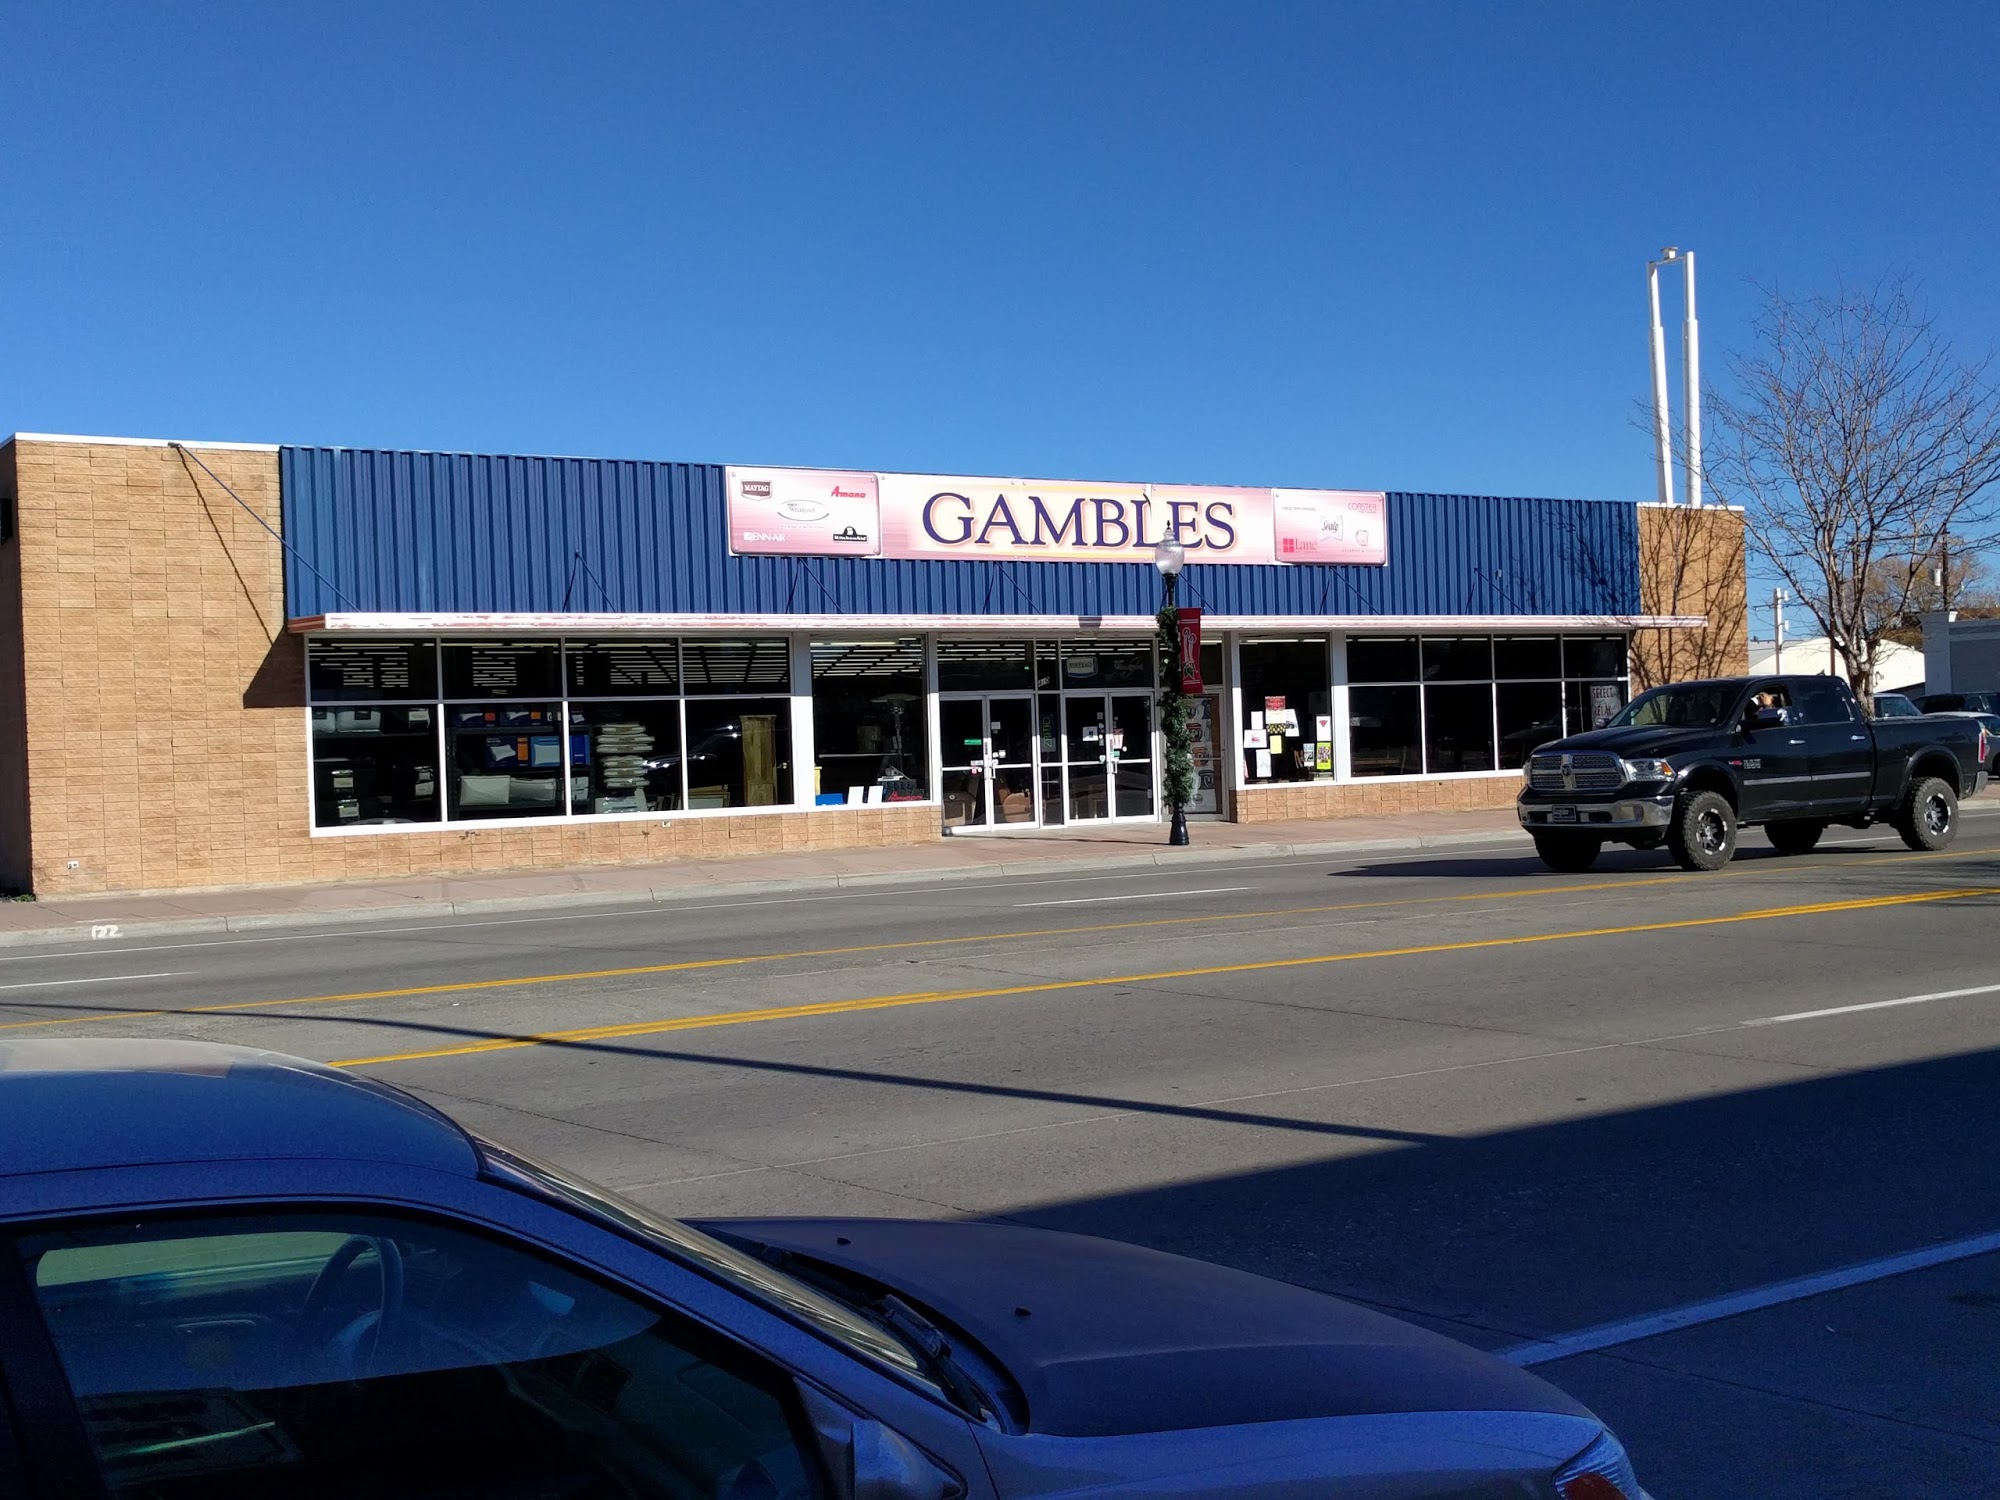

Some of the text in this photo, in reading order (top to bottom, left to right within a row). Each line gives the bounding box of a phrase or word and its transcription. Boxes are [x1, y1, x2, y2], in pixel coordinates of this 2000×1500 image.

[744, 484, 770, 493] MAYTAG
[830, 485, 866, 499] Amana
[1347, 502, 1377, 512] COASTER
[922, 491, 1236, 550] GAMBLES
[1321, 520, 1339, 534] Sealy
[749, 532, 786, 542] JENN-AIR
[1295, 538, 1318, 551] Lane
